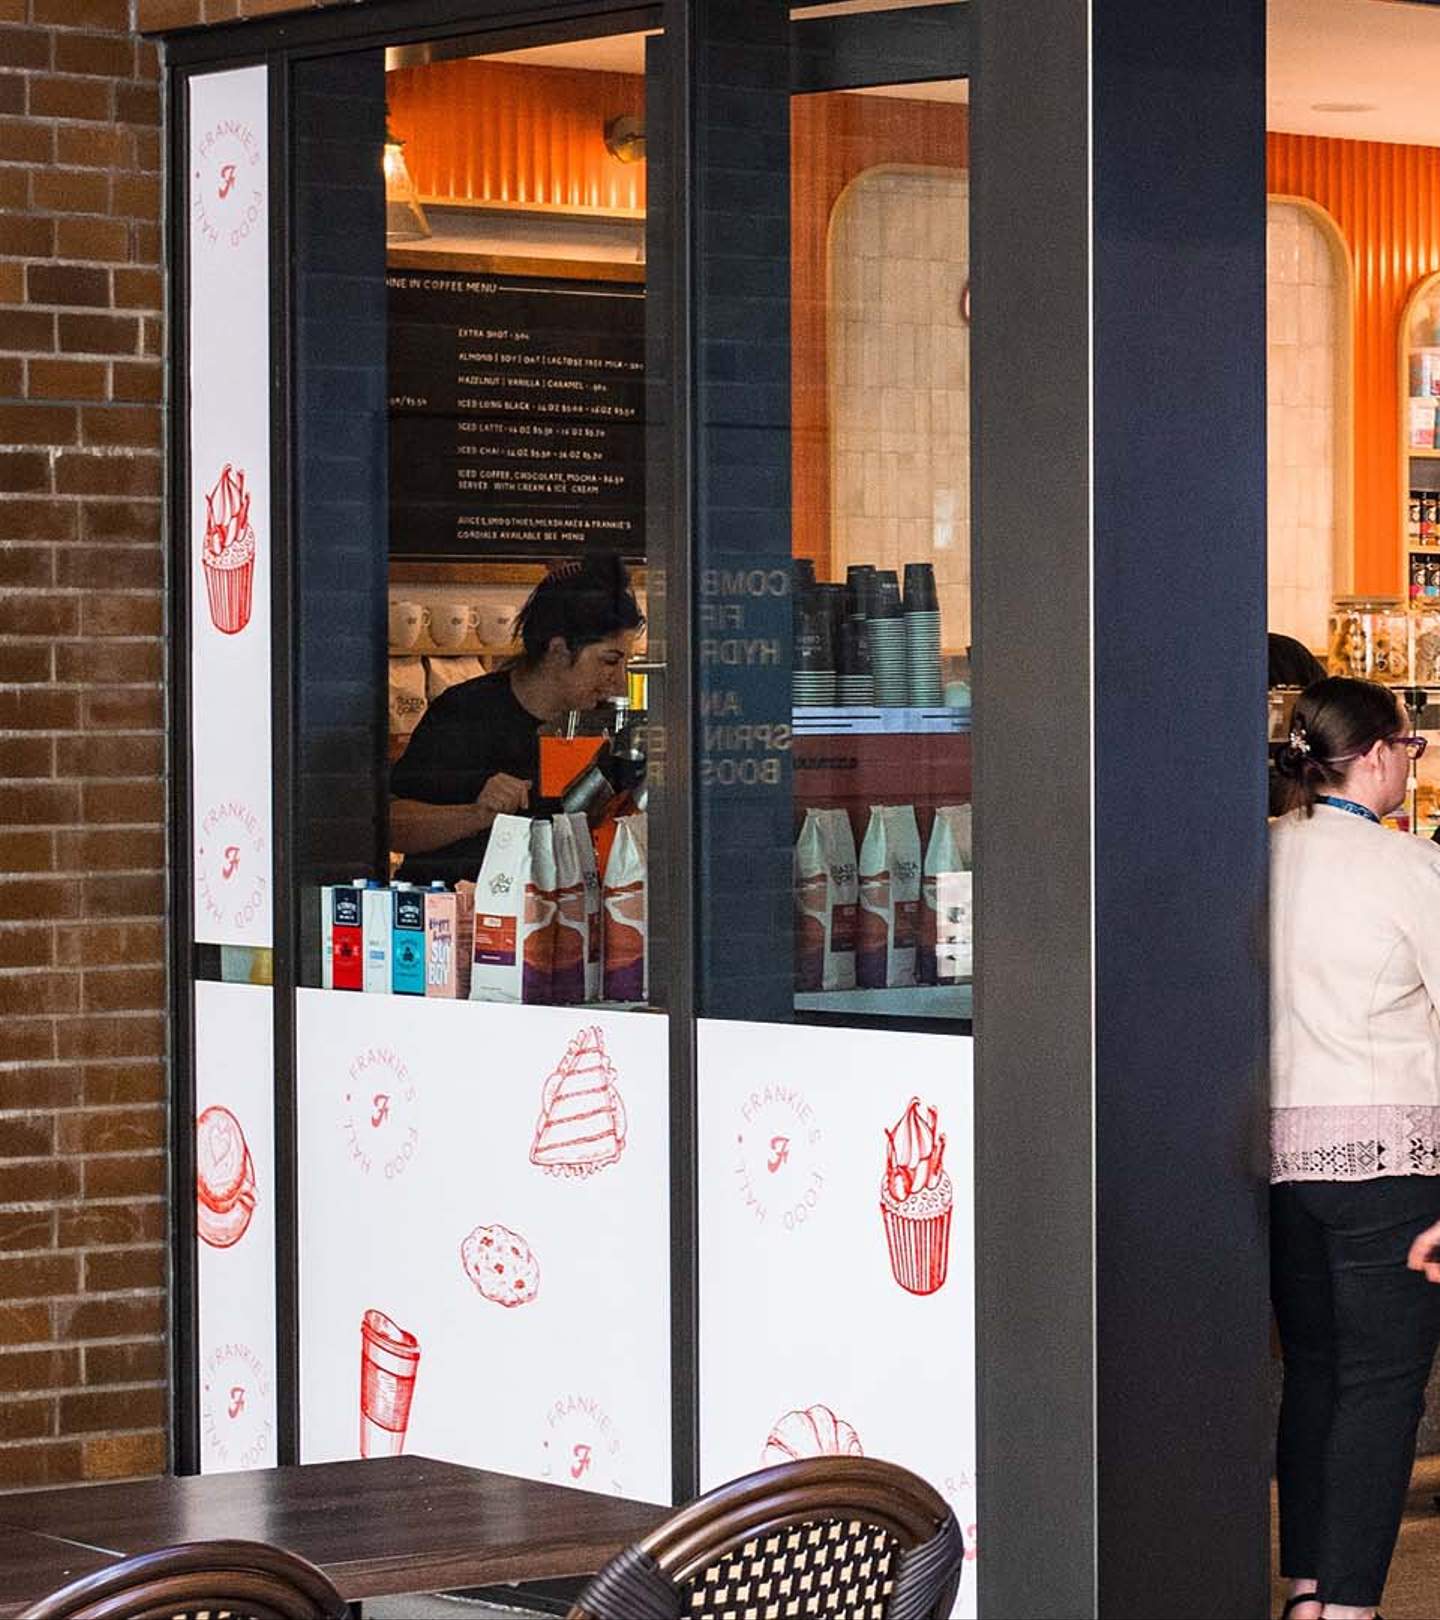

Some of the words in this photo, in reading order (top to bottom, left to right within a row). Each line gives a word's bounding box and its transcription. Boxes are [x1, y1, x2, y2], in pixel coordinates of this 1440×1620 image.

[423, 279, 463, 292] COFFEE
[466, 281, 497, 293] MENU
[458, 328, 483, 337] EXTRA
[457, 400, 478, 409] ICED
[505, 401, 529, 410] BLACK
[480, 423, 503, 432] LATTE
